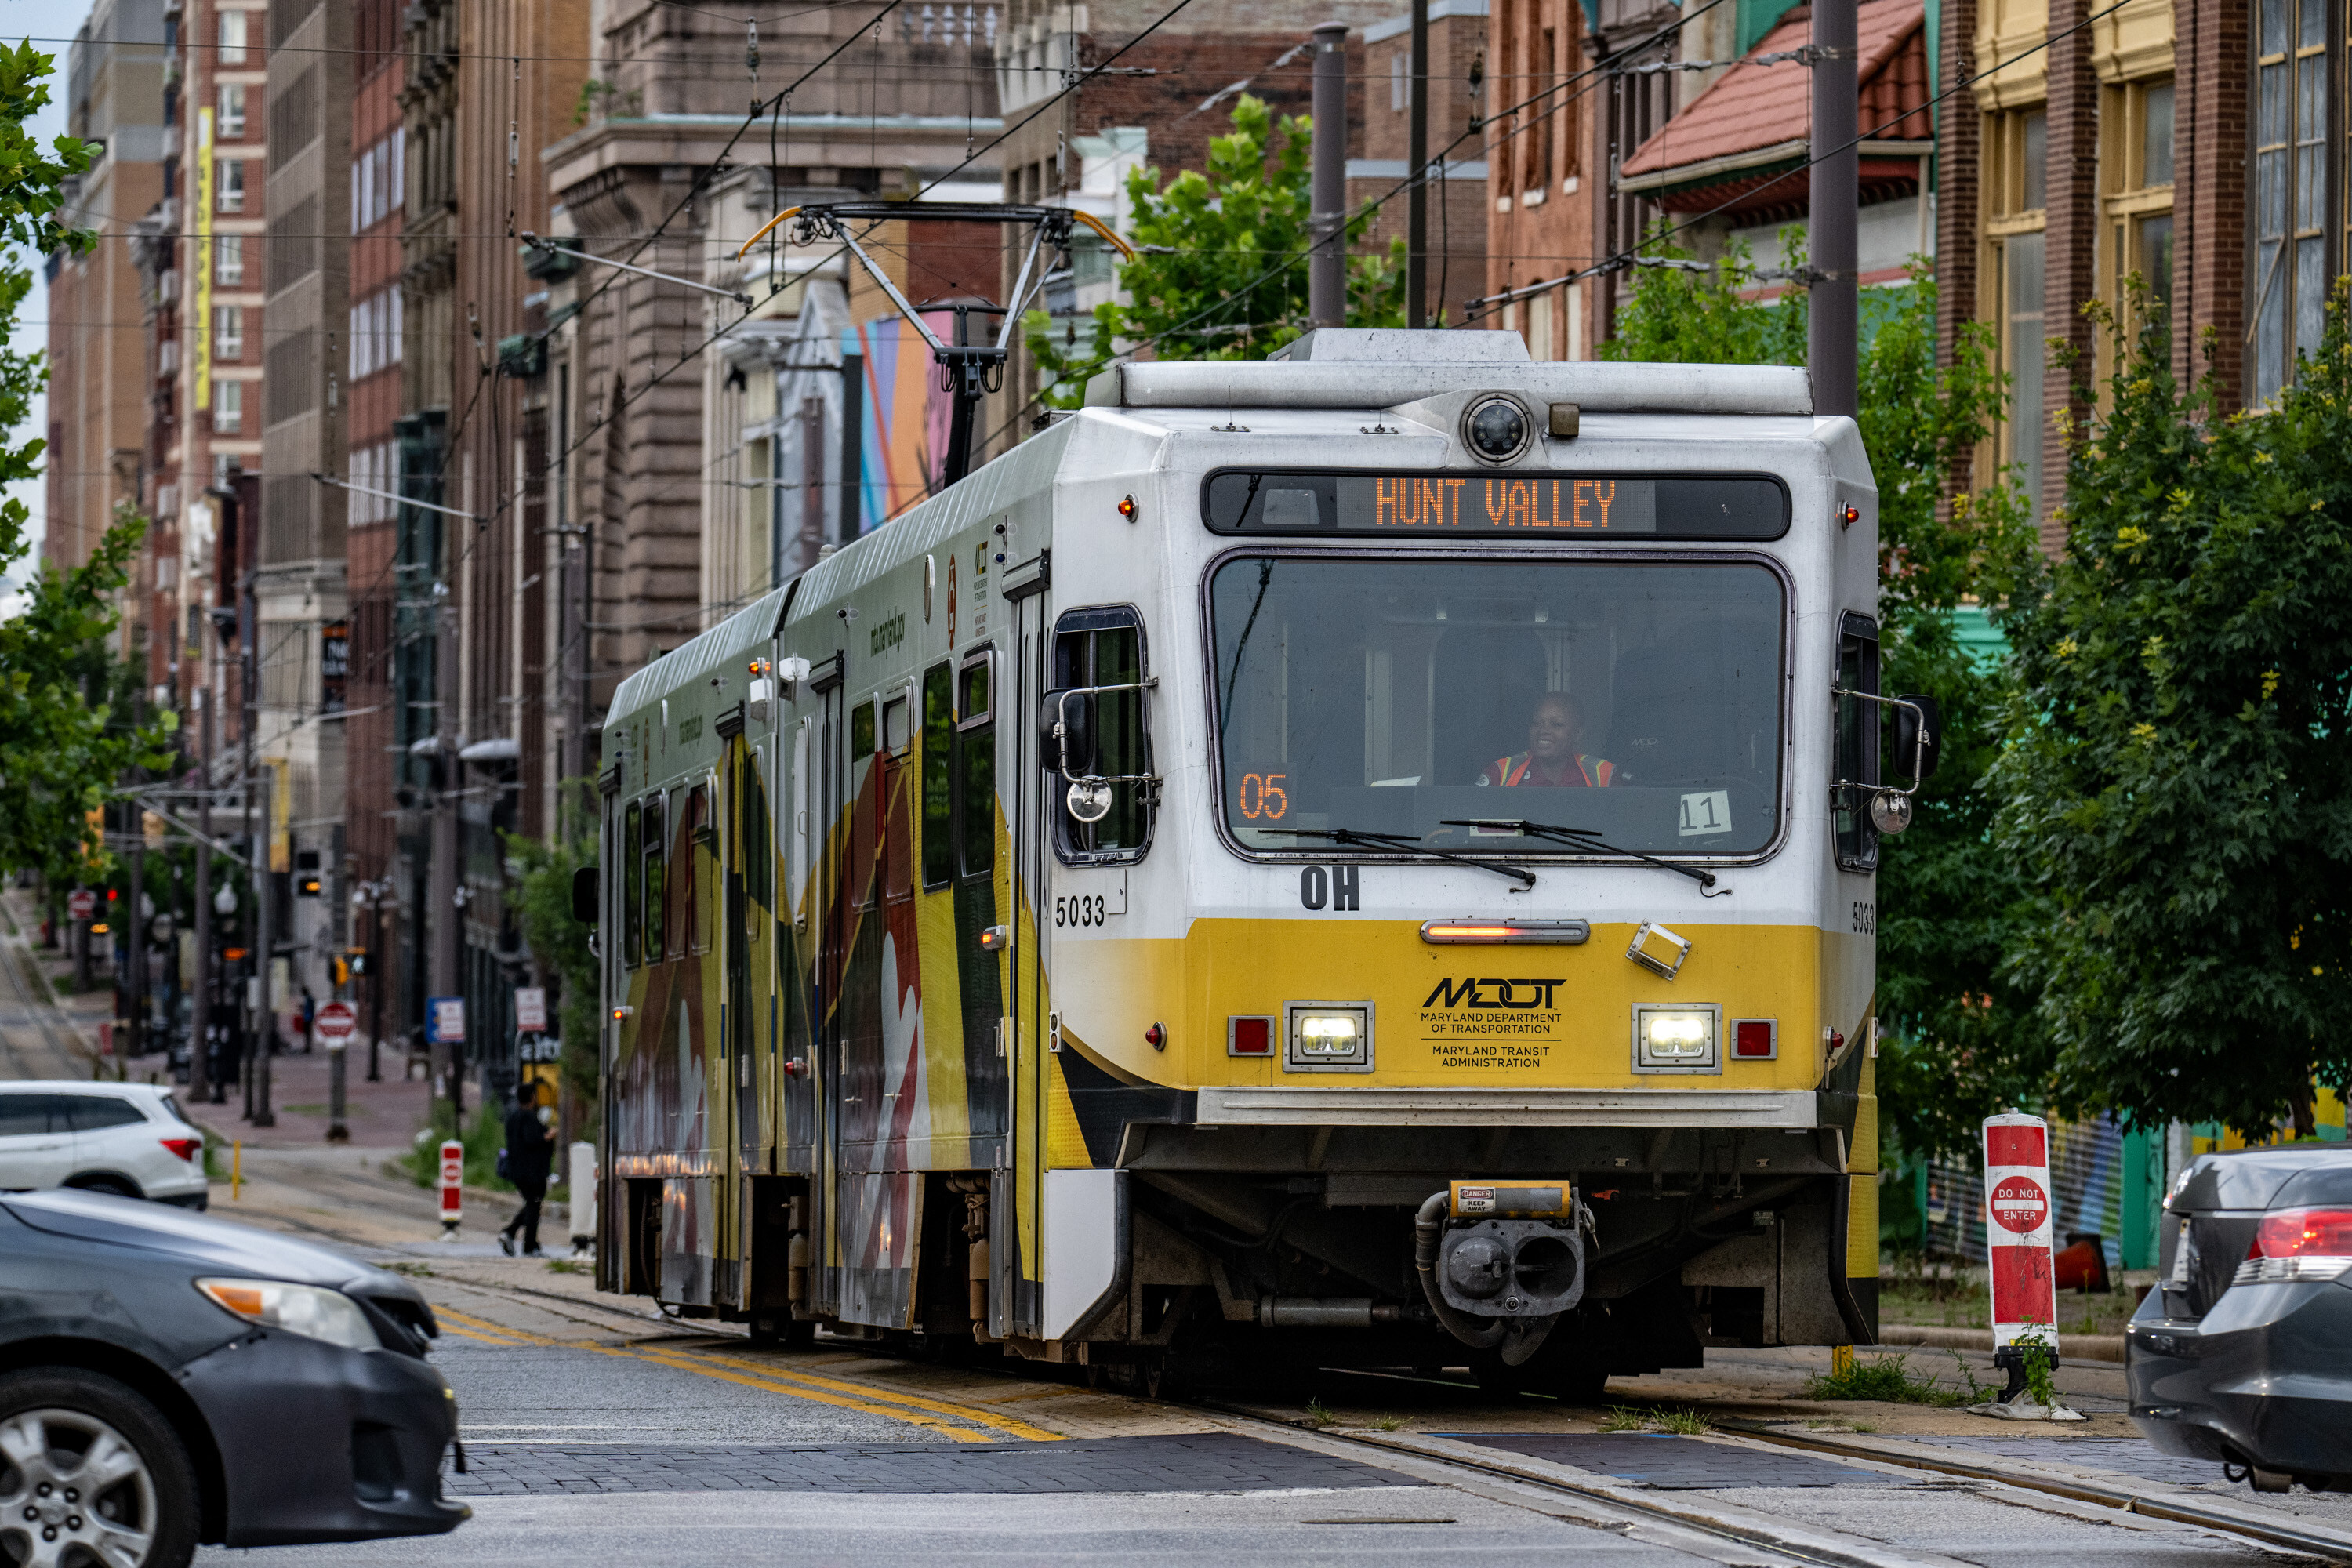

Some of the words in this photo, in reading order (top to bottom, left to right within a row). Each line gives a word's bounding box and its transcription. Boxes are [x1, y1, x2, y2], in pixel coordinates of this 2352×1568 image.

[1377, 477, 1466, 525] HUNT
[1486, 479, 1615, 528] VALLEY
[1240, 773, 1287, 819] 05
[1680, 797, 1721, 830] 11
[1301, 866, 1359, 912] OH
[1055, 895, 1104, 927] 5033
[1853, 902, 1874, 935] 5033
[1422, 978, 1567, 1009] MDOT
[1421, 1012, 1483, 1022] MARYLAND
[1486, 1013, 1562, 1023] DEPARTMENT
[1432, 1024, 1446, 1033] OF
[1450, 1024, 1551, 1034] TRANSPORTATION
[1432, 1046, 1497, 1056] MARYLAND
[1501, 1047, 1550, 1056] TRANSIT
[1441, 1058, 1541, 1068] ADMINISTRATION
[1998, 1189, 2013, 1198] DO
[2020, 1189, 2038, 1199] NOT
[2003, 1210, 2036, 1221] ENTER
